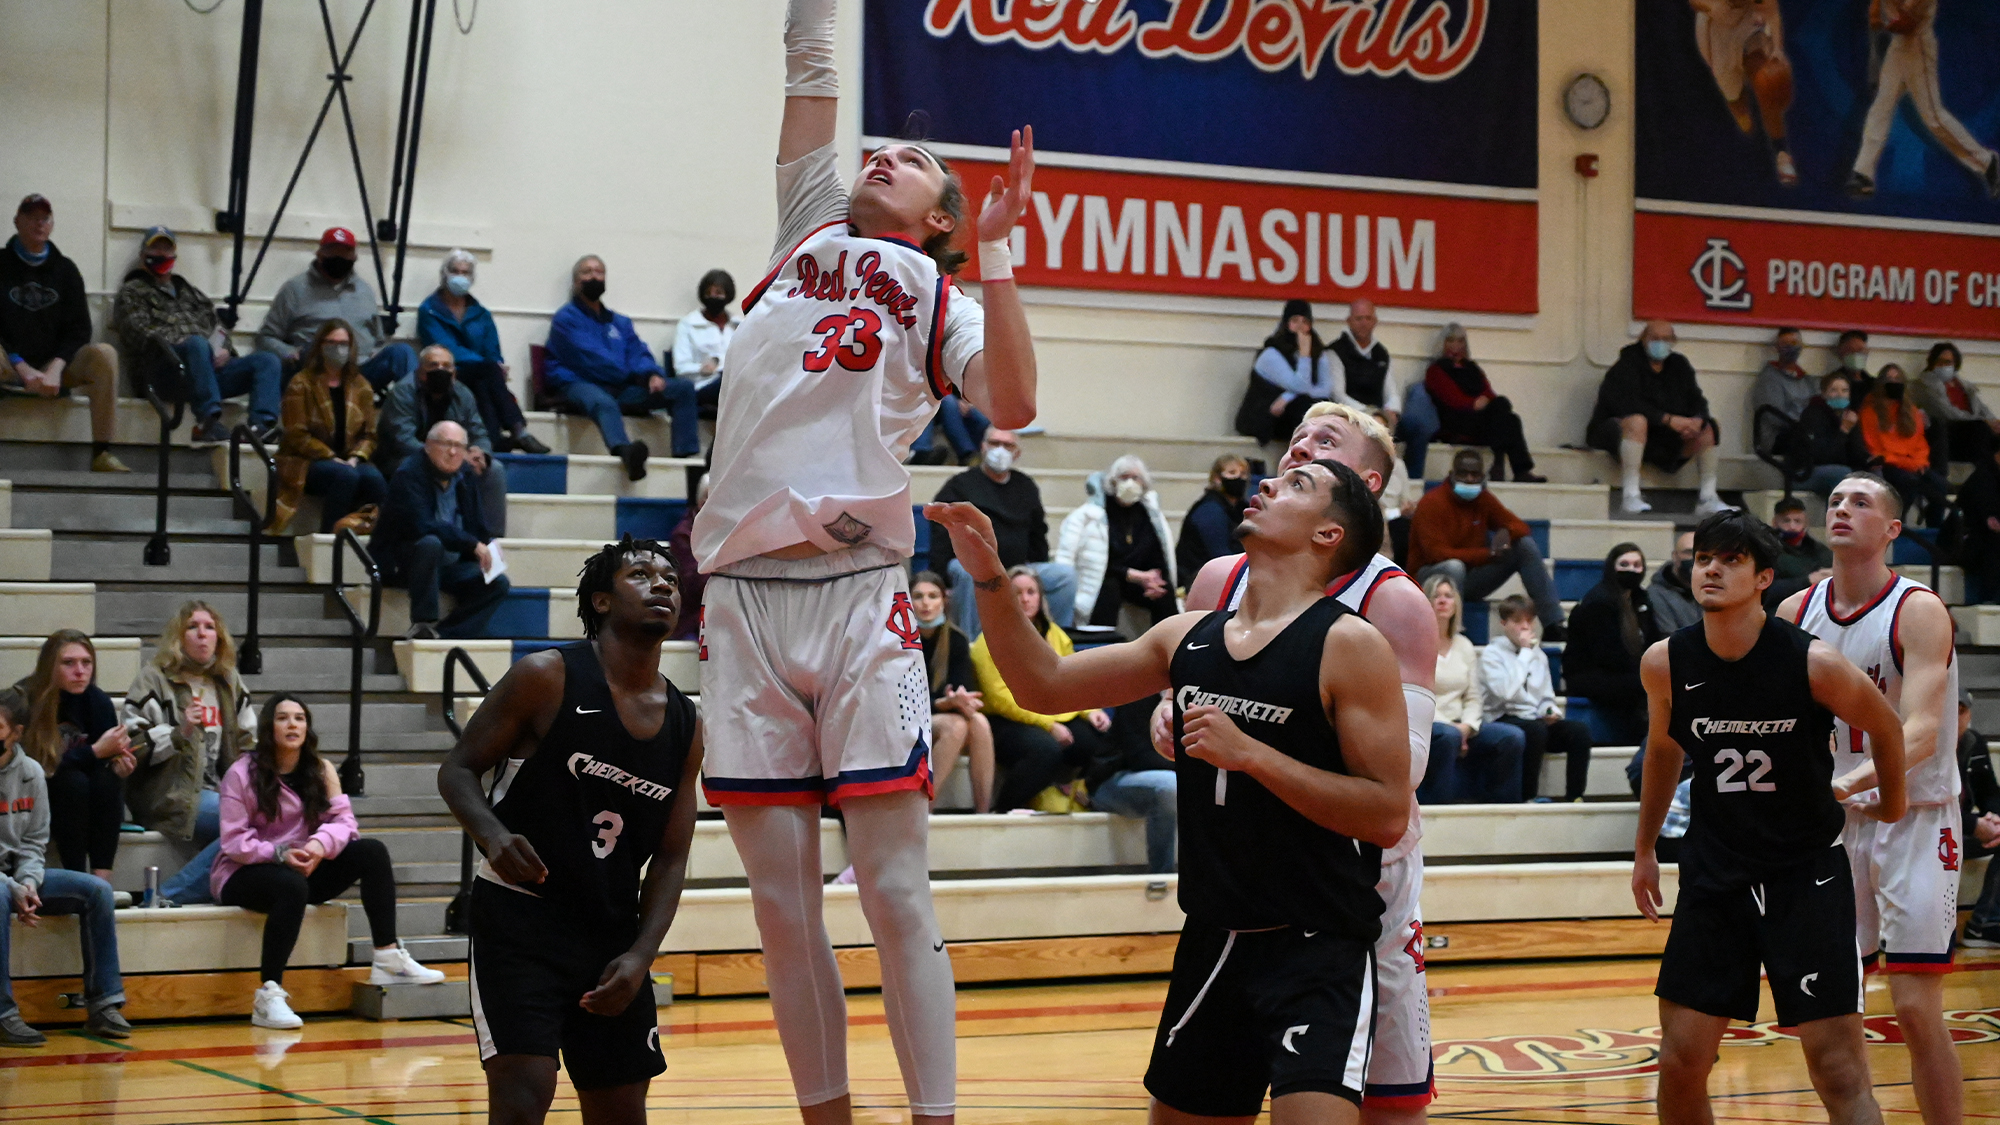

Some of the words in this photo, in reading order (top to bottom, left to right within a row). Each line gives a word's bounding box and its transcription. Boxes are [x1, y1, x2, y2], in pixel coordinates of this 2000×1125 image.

[1136, 0, 1489, 81] Devils
[787, 250, 848, 302] Red
[1768, 258, 1915, 302] PROGRAM
[1924, 268, 1959, 305] OF
[1967, 271, 2000, 308] CH
[803, 306, 883, 372] 33
[1690, 716, 1797, 742] CHEMEKETA
[1714, 748, 1776, 793] 22
[591, 809, 624, 860] 3
